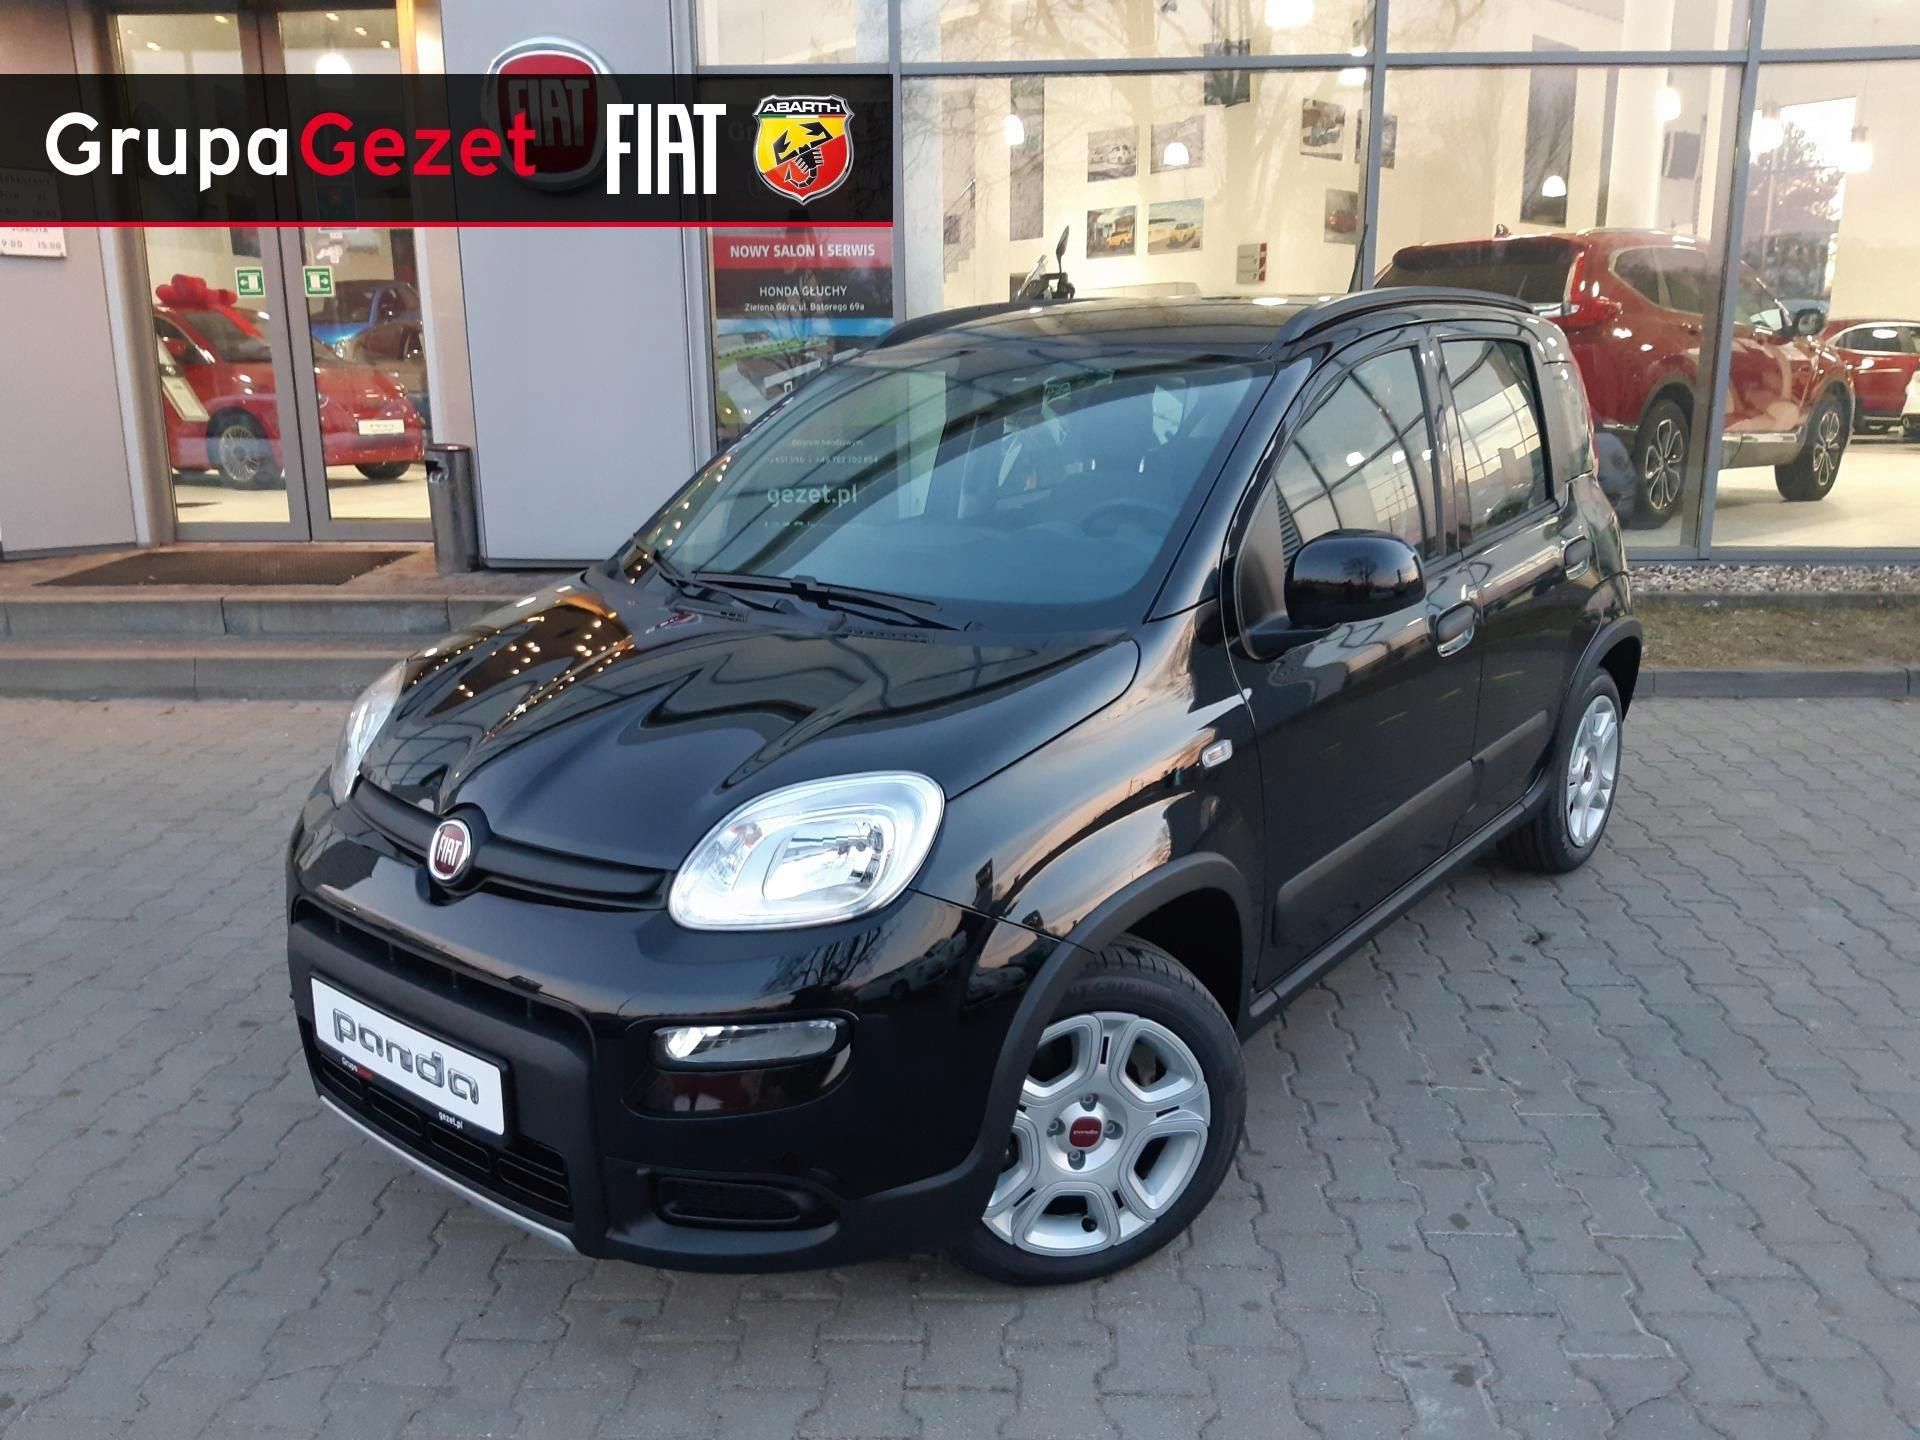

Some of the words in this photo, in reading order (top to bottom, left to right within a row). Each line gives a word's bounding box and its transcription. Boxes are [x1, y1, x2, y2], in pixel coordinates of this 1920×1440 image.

[730, 244, 770, 258] NOWY
[773, 243, 815, 257] SALON
[819, 244, 823, 257] I
[827, 243, 876, 257] SERWIS
[759, 285, 800, 297] HONDA
[802, 285, 848, 297] GŁUCHY
[744, 302, 774, 312] Zielona
[810, 302, 848, 312] Batorego
[767, 483, 858, 508] gezet.pl
[436, 835, 463, 867] FIAT
[332, 1008, 480, 1105] panda
[438, 1111, 464, 1130] gezet.pl
